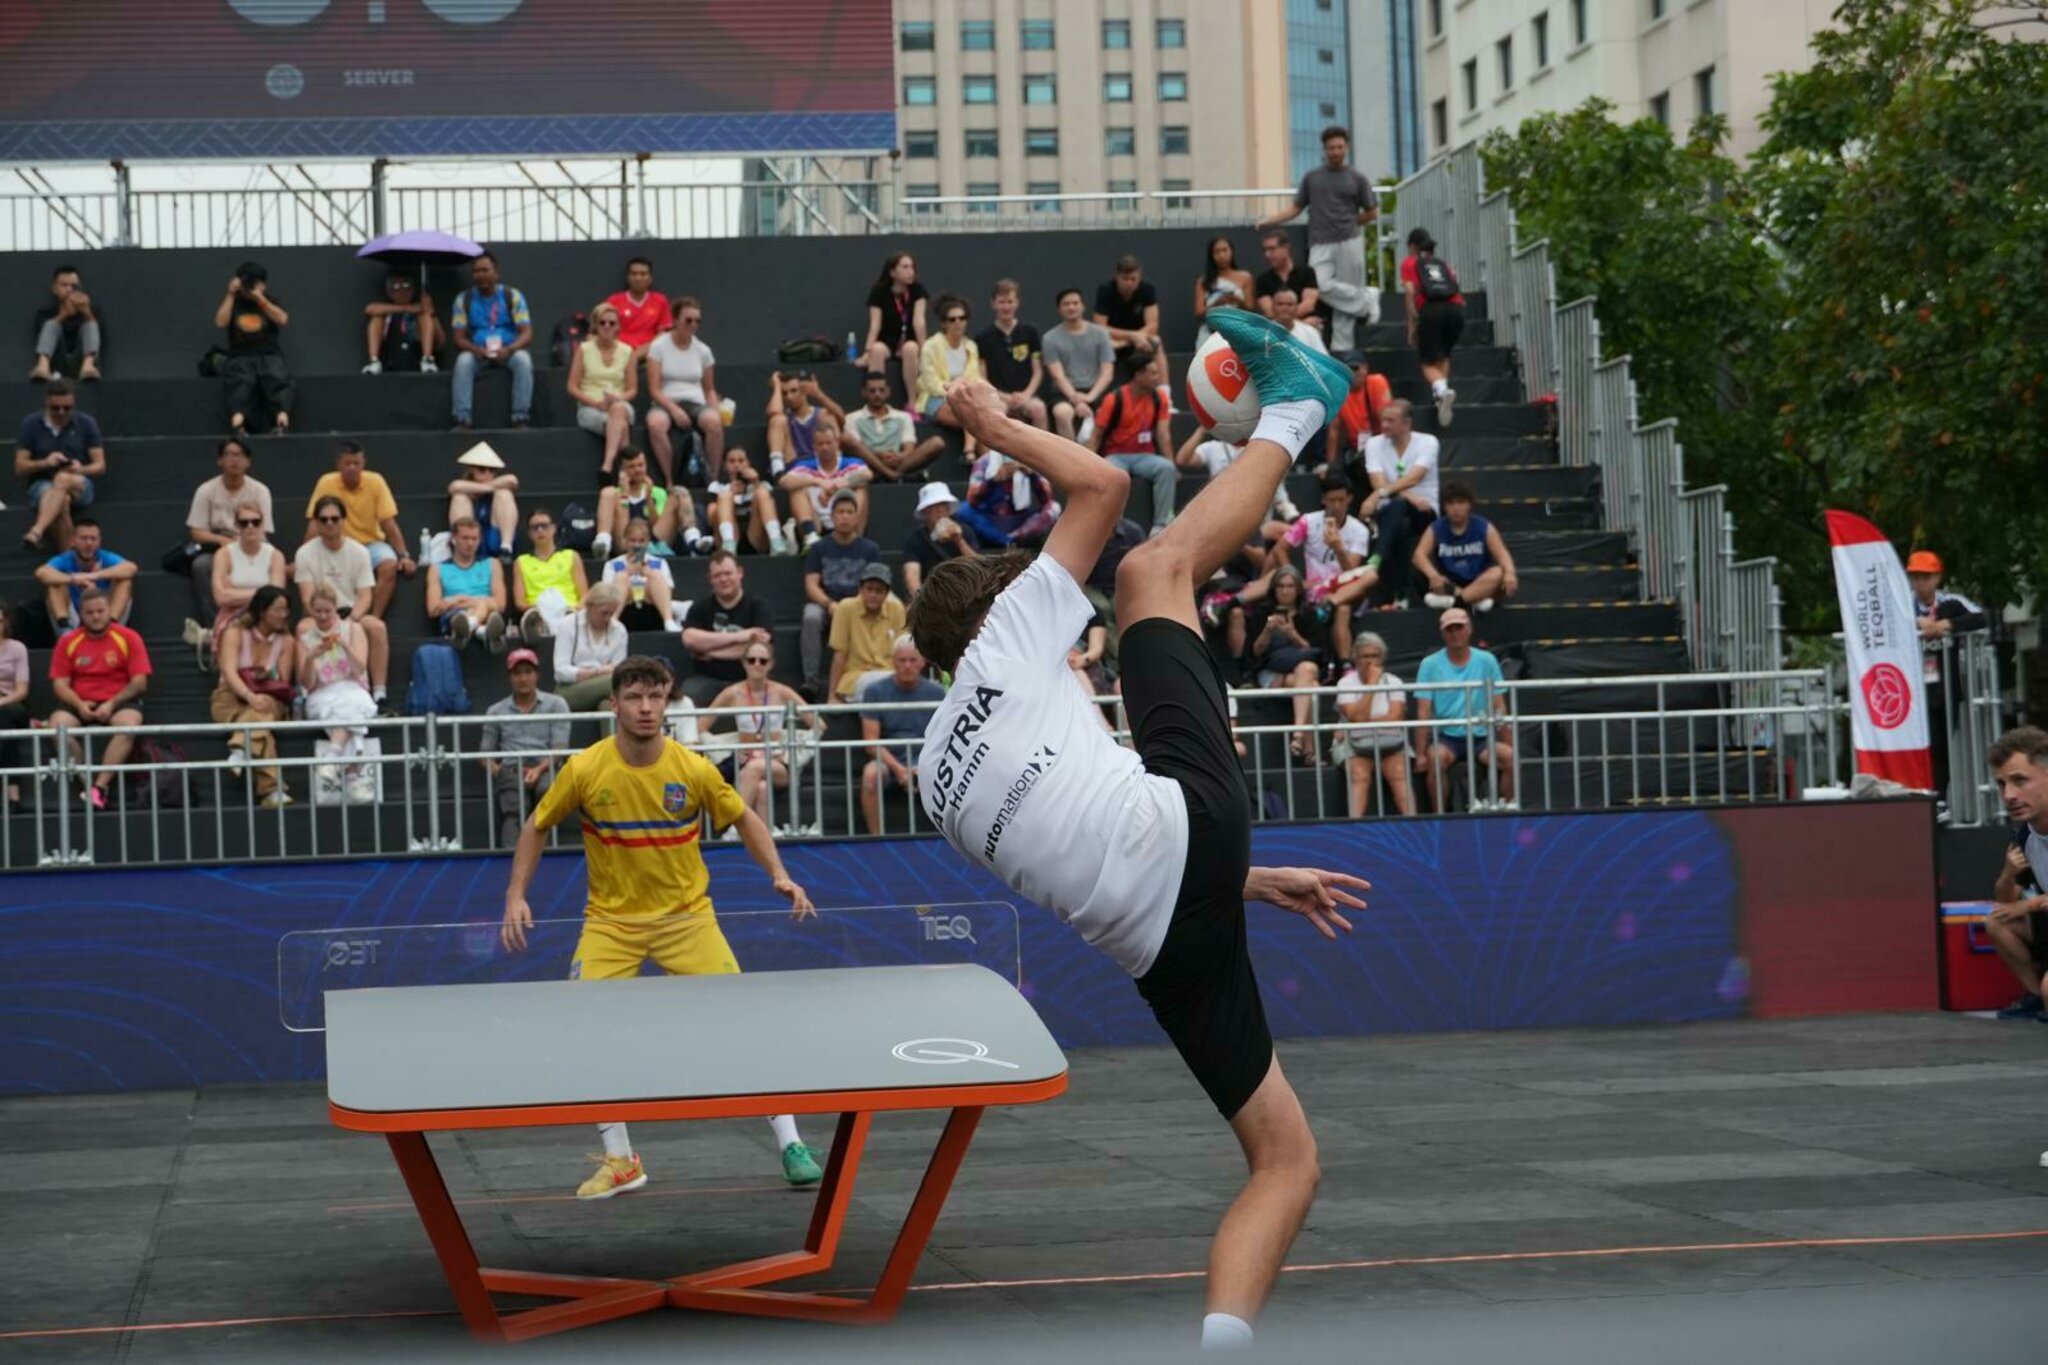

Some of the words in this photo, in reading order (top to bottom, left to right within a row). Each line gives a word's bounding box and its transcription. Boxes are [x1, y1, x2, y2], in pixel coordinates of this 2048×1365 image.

[343, 69, 415, 86] SERVER
[1857, 590, 1871, 650] WORLD
[1865, 562, 1885, 649] TEQBALL
[931, 685, 1004, 832] AUSTRIA
[949, 741, 990, 811] Hamm
[918, 914, 977, 945] TEQ
